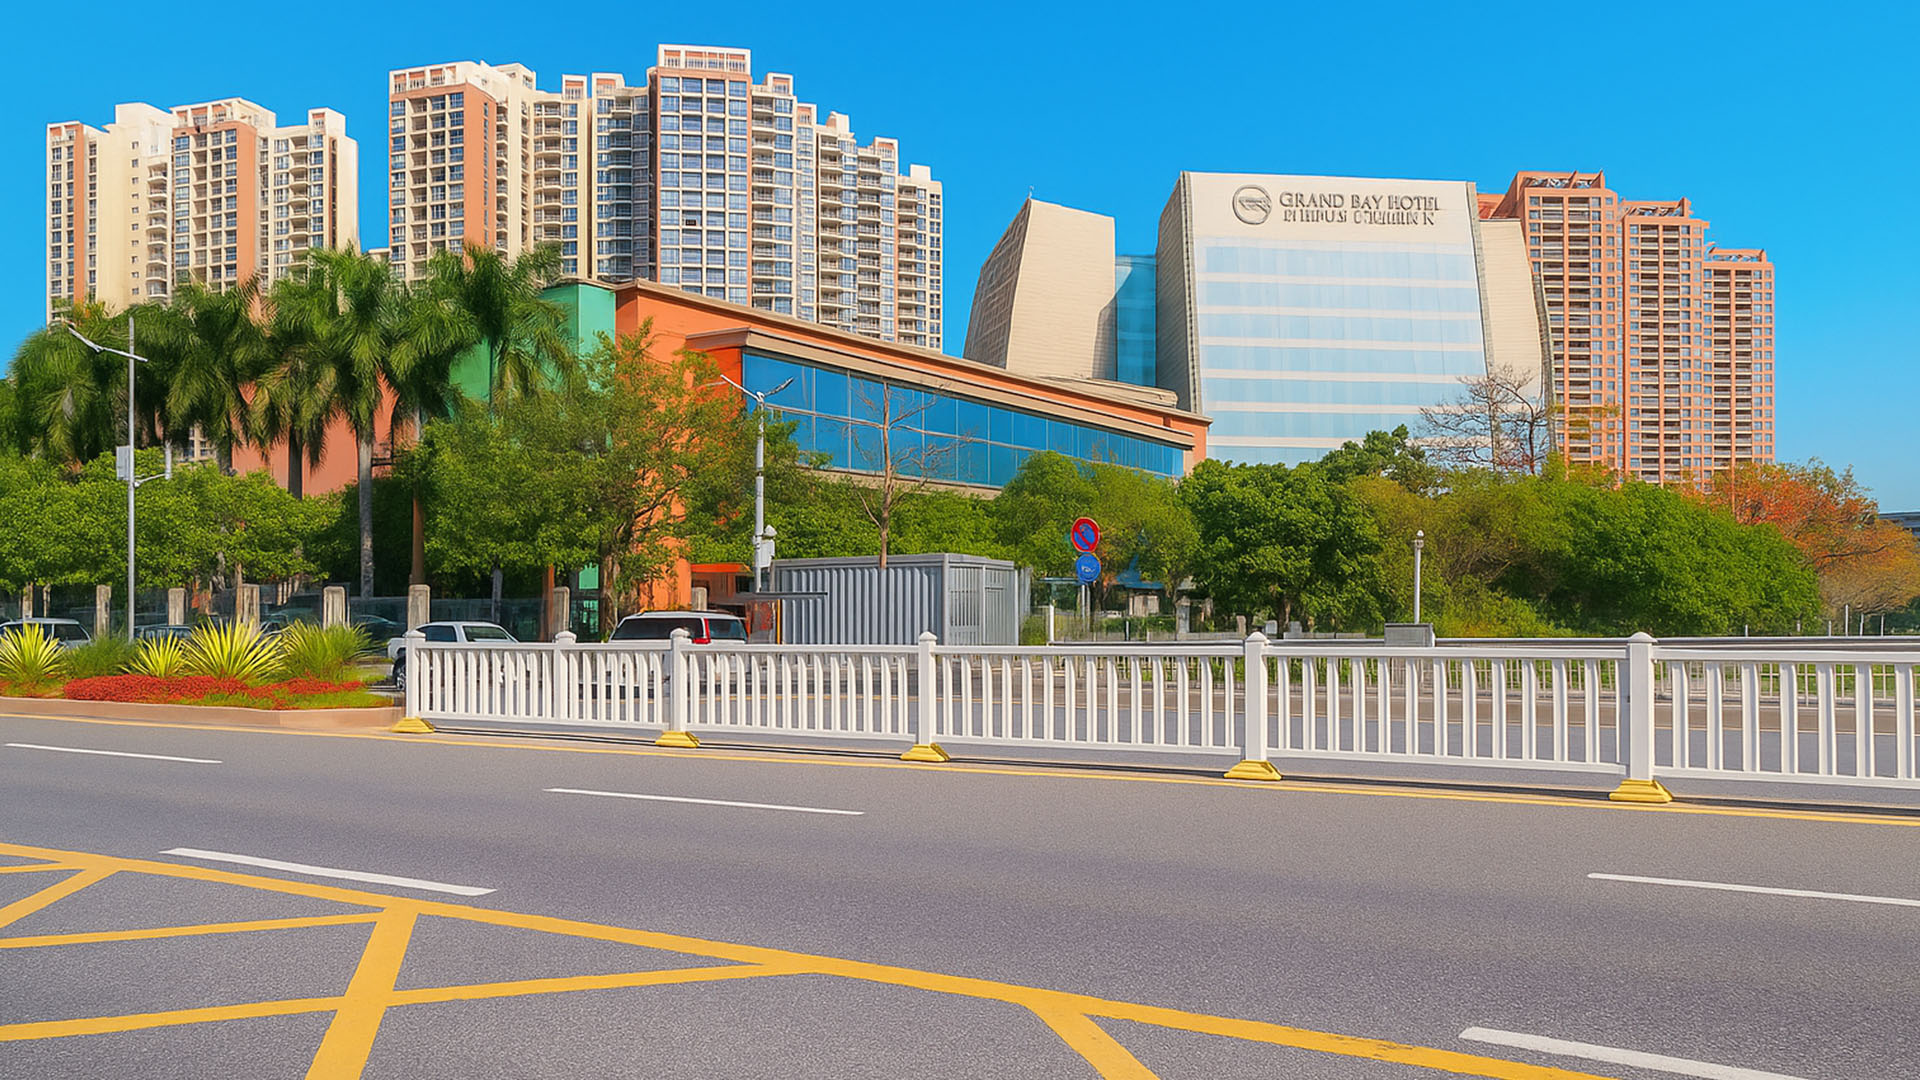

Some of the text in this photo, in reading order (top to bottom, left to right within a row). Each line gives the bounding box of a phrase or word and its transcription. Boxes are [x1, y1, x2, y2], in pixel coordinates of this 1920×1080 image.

[1279, 192, 1440, 211] GRAND BAY HOTEL
